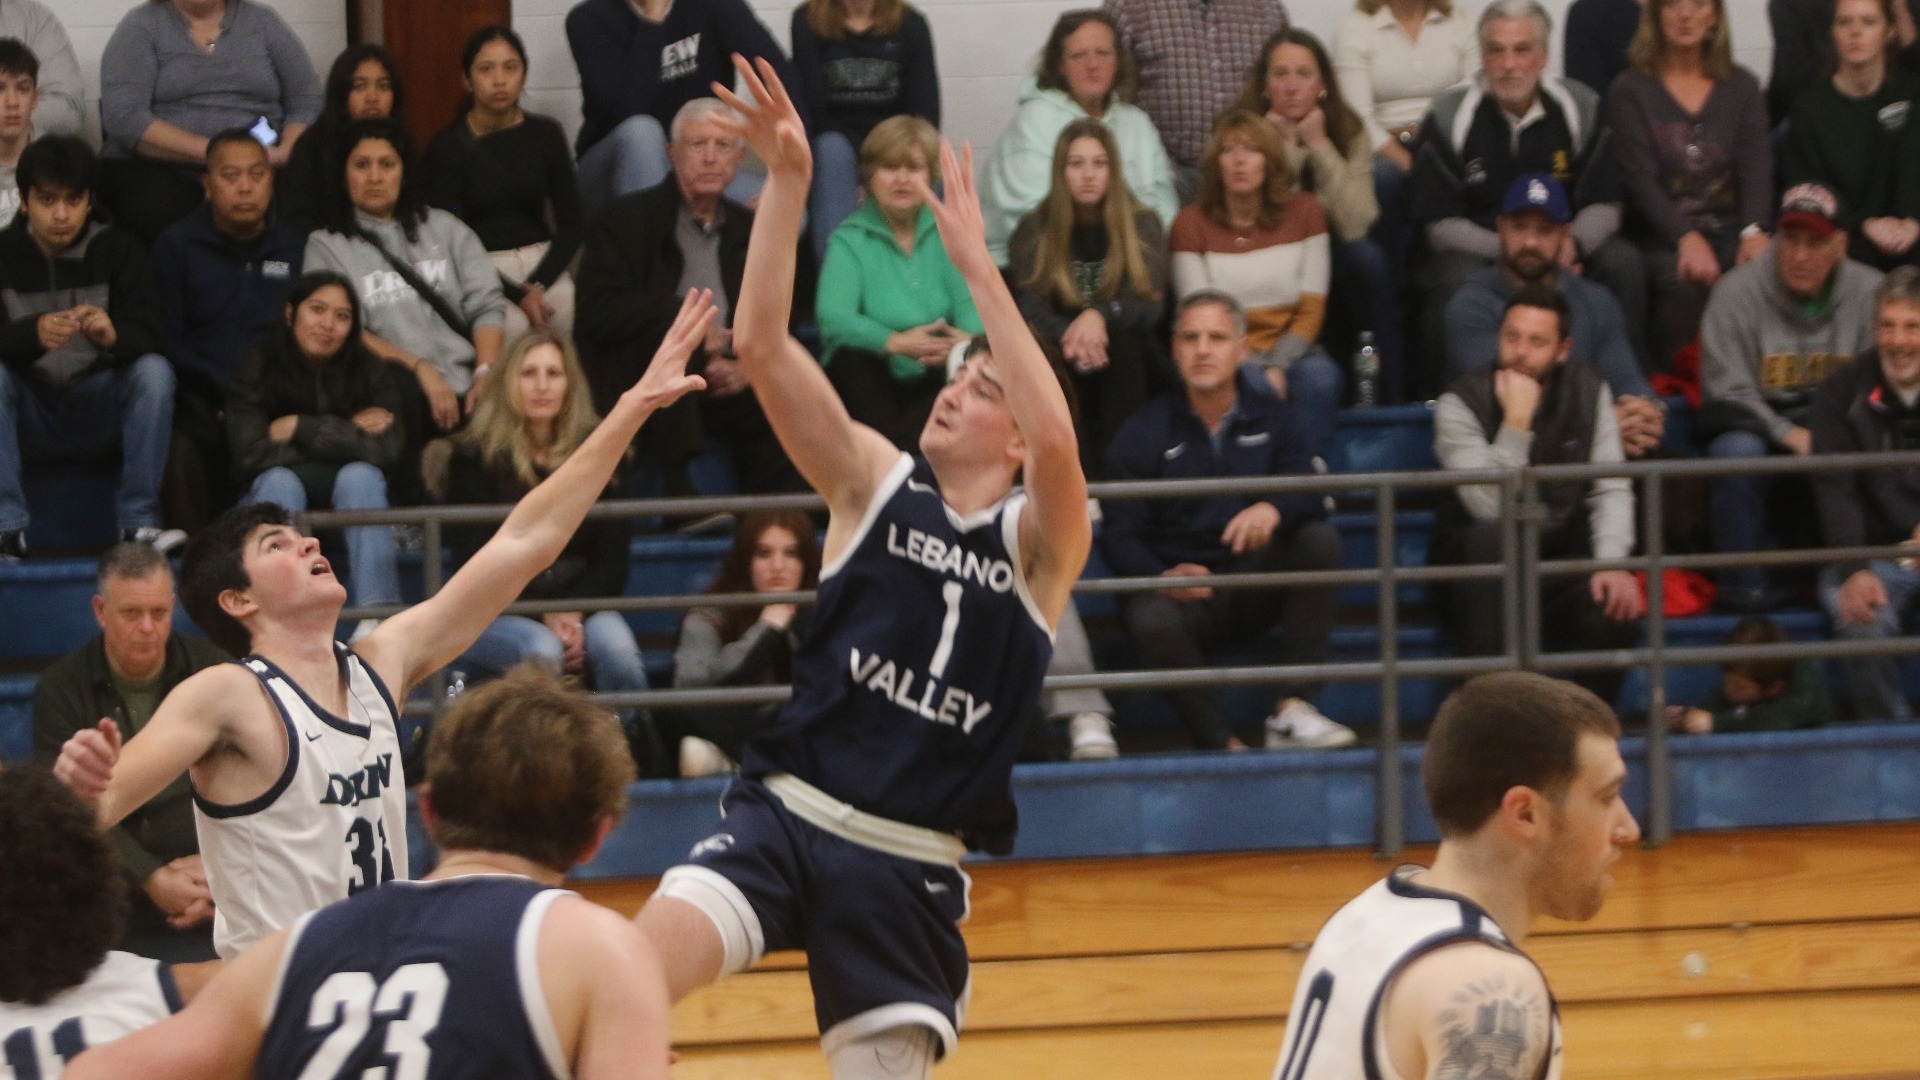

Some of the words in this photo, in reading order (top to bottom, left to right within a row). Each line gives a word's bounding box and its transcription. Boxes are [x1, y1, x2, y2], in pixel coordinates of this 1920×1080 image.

[362, 259, 448, 297] DRW
[887, 522, 1018, 596] LEBANO
[929, 579, 964, 679] 1
[849, 646, 994, 735] VALLEY
[299, 962, 450, 1080] 23
